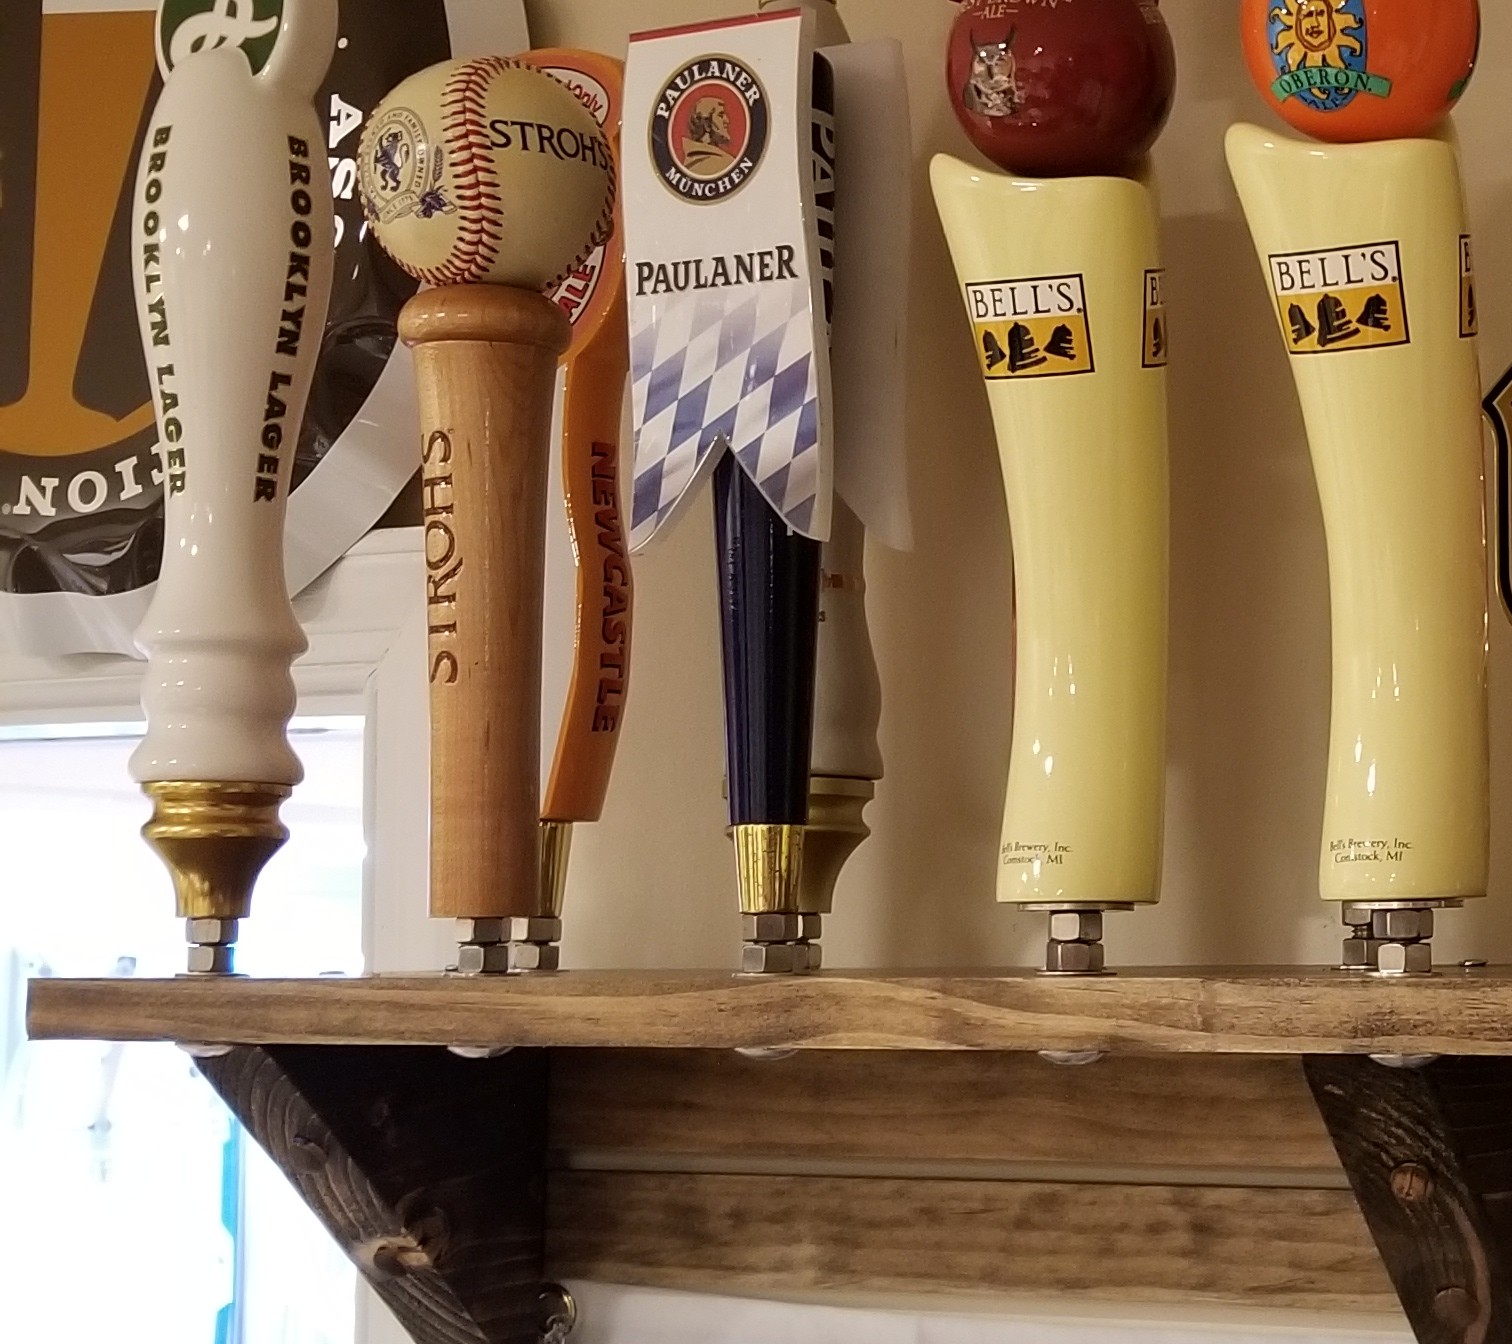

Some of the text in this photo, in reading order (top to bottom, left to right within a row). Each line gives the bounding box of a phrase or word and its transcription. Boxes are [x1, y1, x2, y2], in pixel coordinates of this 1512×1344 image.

[656, 60, 761, 120] PAULANER
[665, 157, 753, 197] MÜNCHEN
[635, 244, 799, 297] PAULANER
[143, 124, 188, 499] BROOKLYN LAGER
[252, 134, 310, 504] BROOKLYN LAGER
[591, 441, 629, 734] NEWCASTLE
[1046, 854, 1064, 865] MI
[1386, 850, 1404, 862] MI
